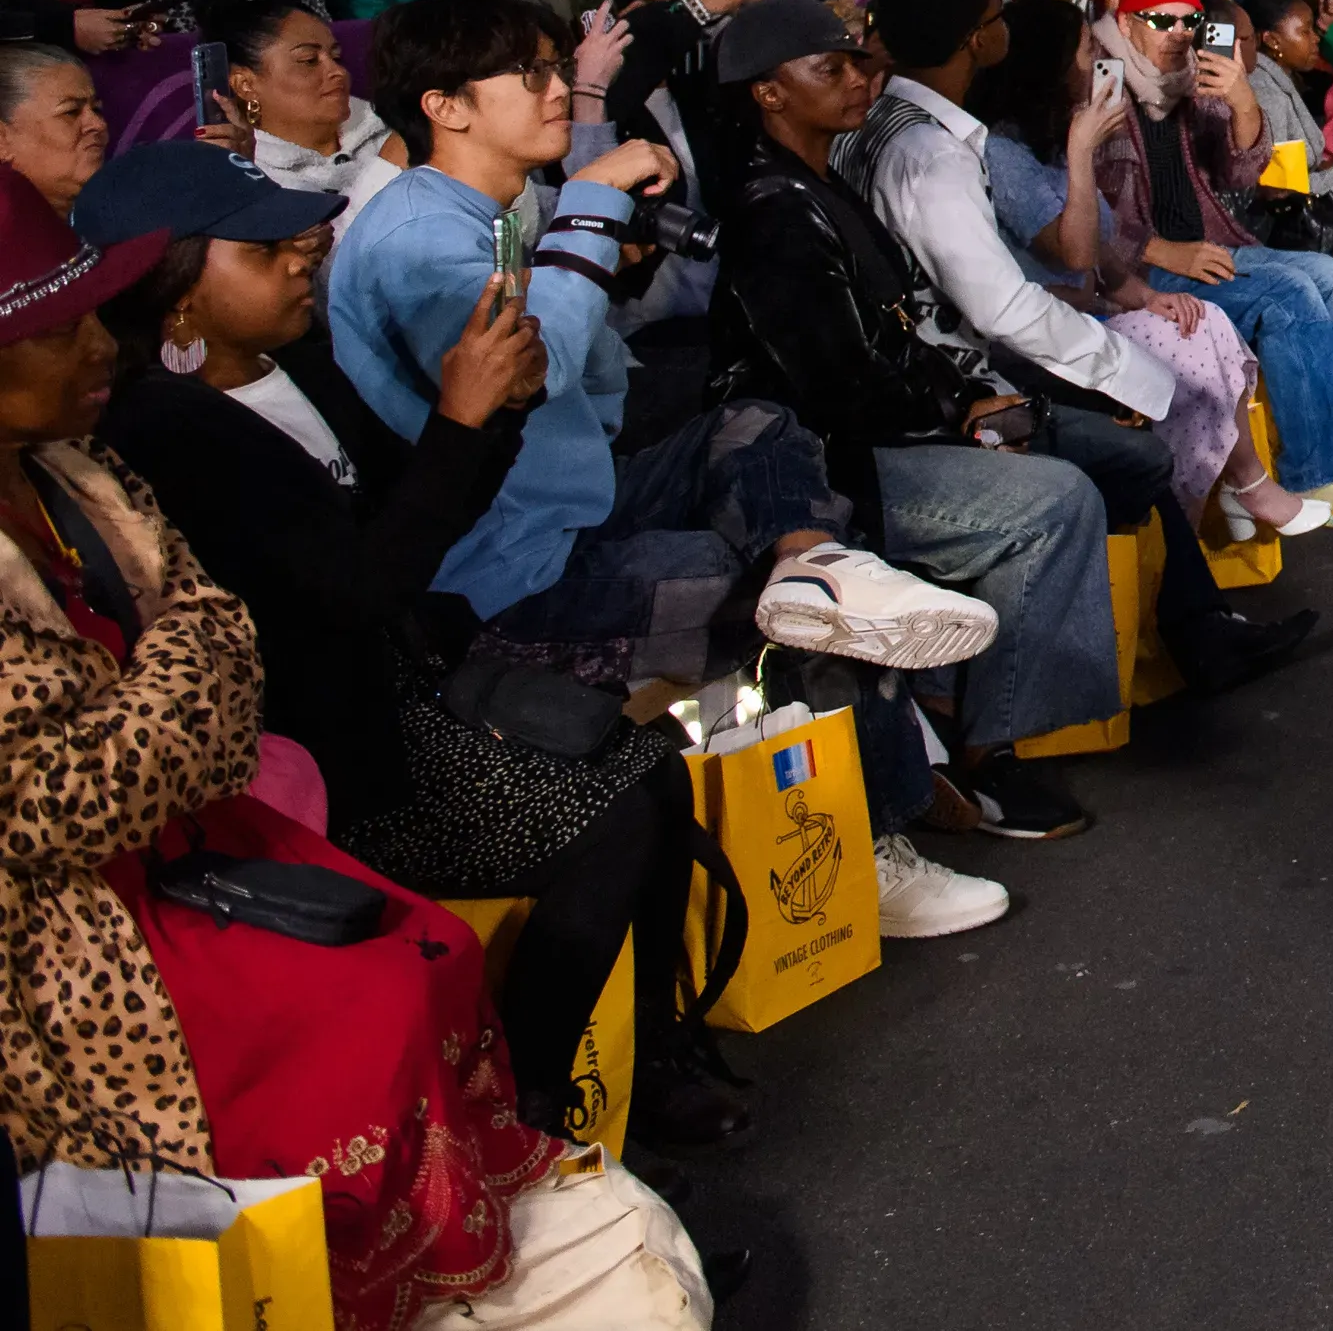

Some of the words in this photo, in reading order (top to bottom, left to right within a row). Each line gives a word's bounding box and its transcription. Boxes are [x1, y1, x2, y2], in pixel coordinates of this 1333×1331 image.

[570, 218, 604, 229] Canon
[779, 858, 811, 906] BEYOND
[811, 825, 833, 865] RETRO
[773, 943, 808, 975] VINTAGE
[810, 923, 853, 955] CLOTHING
